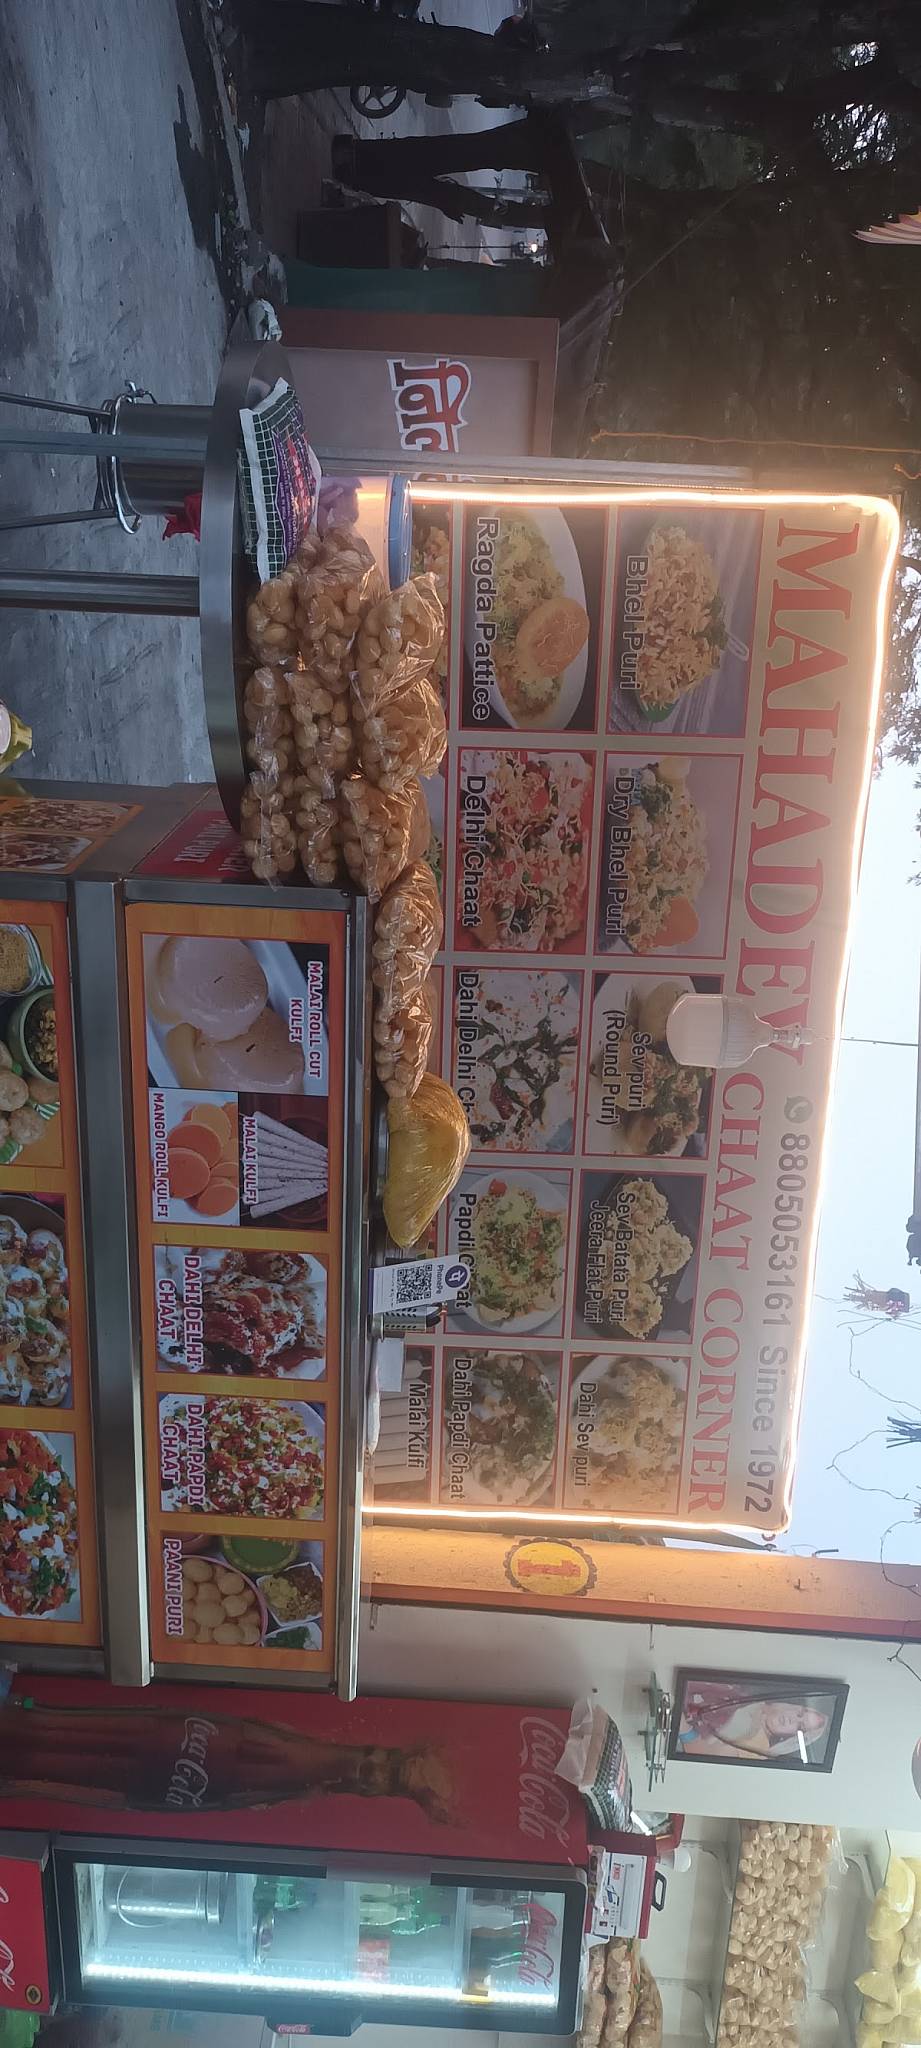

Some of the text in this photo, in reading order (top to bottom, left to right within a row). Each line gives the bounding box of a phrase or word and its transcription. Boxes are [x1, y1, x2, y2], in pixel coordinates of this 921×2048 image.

[471, 517, 500, 720] Ragda Pattice
[620, 555, 649, 690] Bhel Puri
[607, 776, 635, 820] Dry
[462, 775, 487, 926] Delhi Chaat
[608, 826, 633, 881] Bhel
[605, 887, 628, 936] Puri
[290, 999, 302, 1041] KULFI
[309, 962, 321, 1078] MALAI ROLL CUT
[458, 972, 480, 1020] Dahi
[688, 518, 860, 1514] MAHADEV CHAAT CORNER
[457, 1027, 479, 1080] Delhi
[596, 1009, 625, 1125] (Round Puri)
[627, 1031, 651, 1109] Sev puri
[154, 1093, 168, 1218] MANGO ROLL KULFI
[245, 1119, 257, 1202] MALAI KULFI
[454, 1193, 477, 1247] Papdi
[584, 1201, 609, 1323] Jeera Flat Puri
[609, 1192, 636, 1322] Sev Batata Puri
[158, 1280, 176, 1340] CHAAT
[185, 1256, 203, 1364] DAHI DELHI
[436, 1264, 444, 1294] PhonePe
[744, 1133, 811, 1513] 8805053161 Since 1972
[162, 1424, 179, 1482] CHAAT
[188, 1404, 204, 1505] DAHI PAPDI
[407, 1382, 428, 1469] Malai Kulfi
[449, 1358, 472, 1499] Dahi Papdi Chaat
[572, 1382, 597, 1487] Dahi Sev puri
[164, 1538, 182, 1635] PAANI PURI
[164, 1717, 219, 1807] Coca-Cola
